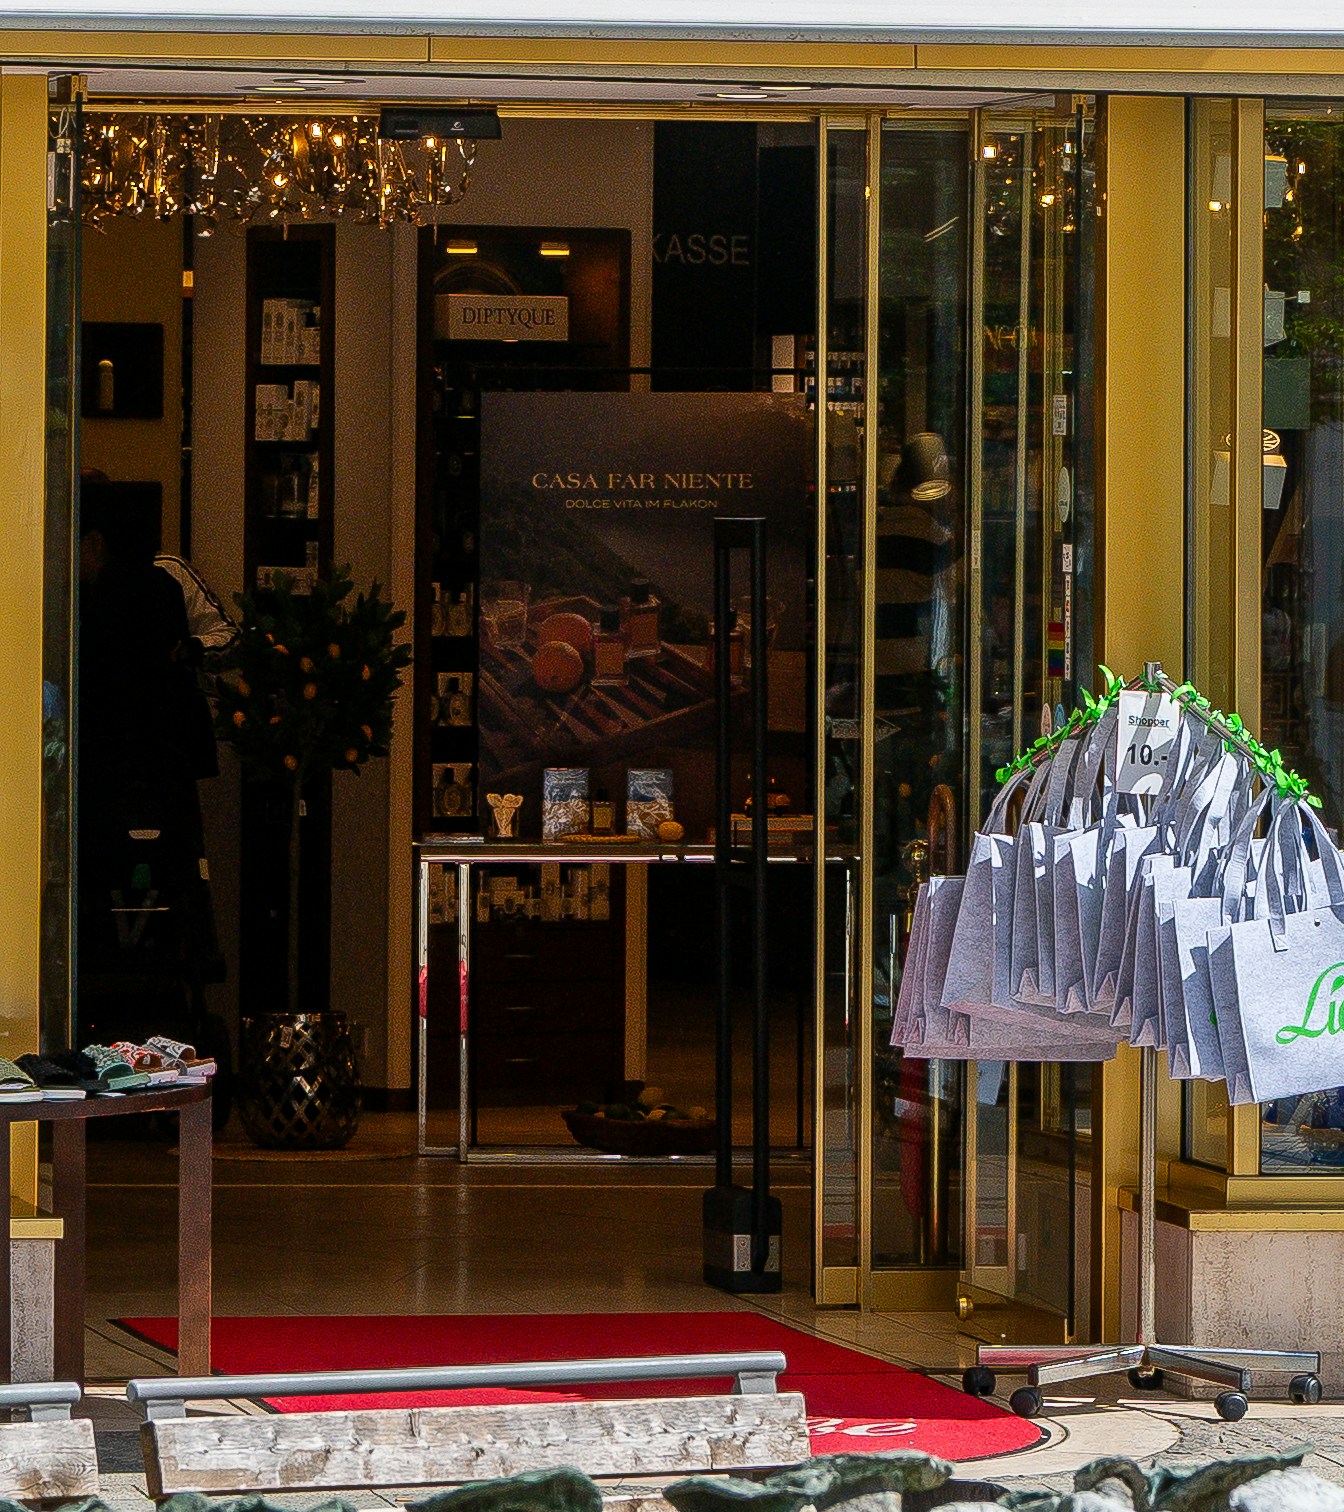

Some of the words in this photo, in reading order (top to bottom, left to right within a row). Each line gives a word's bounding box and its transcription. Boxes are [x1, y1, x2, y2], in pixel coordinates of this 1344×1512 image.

[462, 307, 556, 328] DIPTYQUE
[531, 472, 600, 490] CASA
[608, 472, 656, 490] FAR
[664, 472, 755, 490] NIENTE
[565, 499, 611, 510] DOLCE
[613, 499, 641, 510] VITA
[645, 499, 660, 510] IM
[663, 499, 718, 510] FLAKON
[1128, 715, 1170, 728] Shopper
[1127, 743, 1168, 766] 10.-
